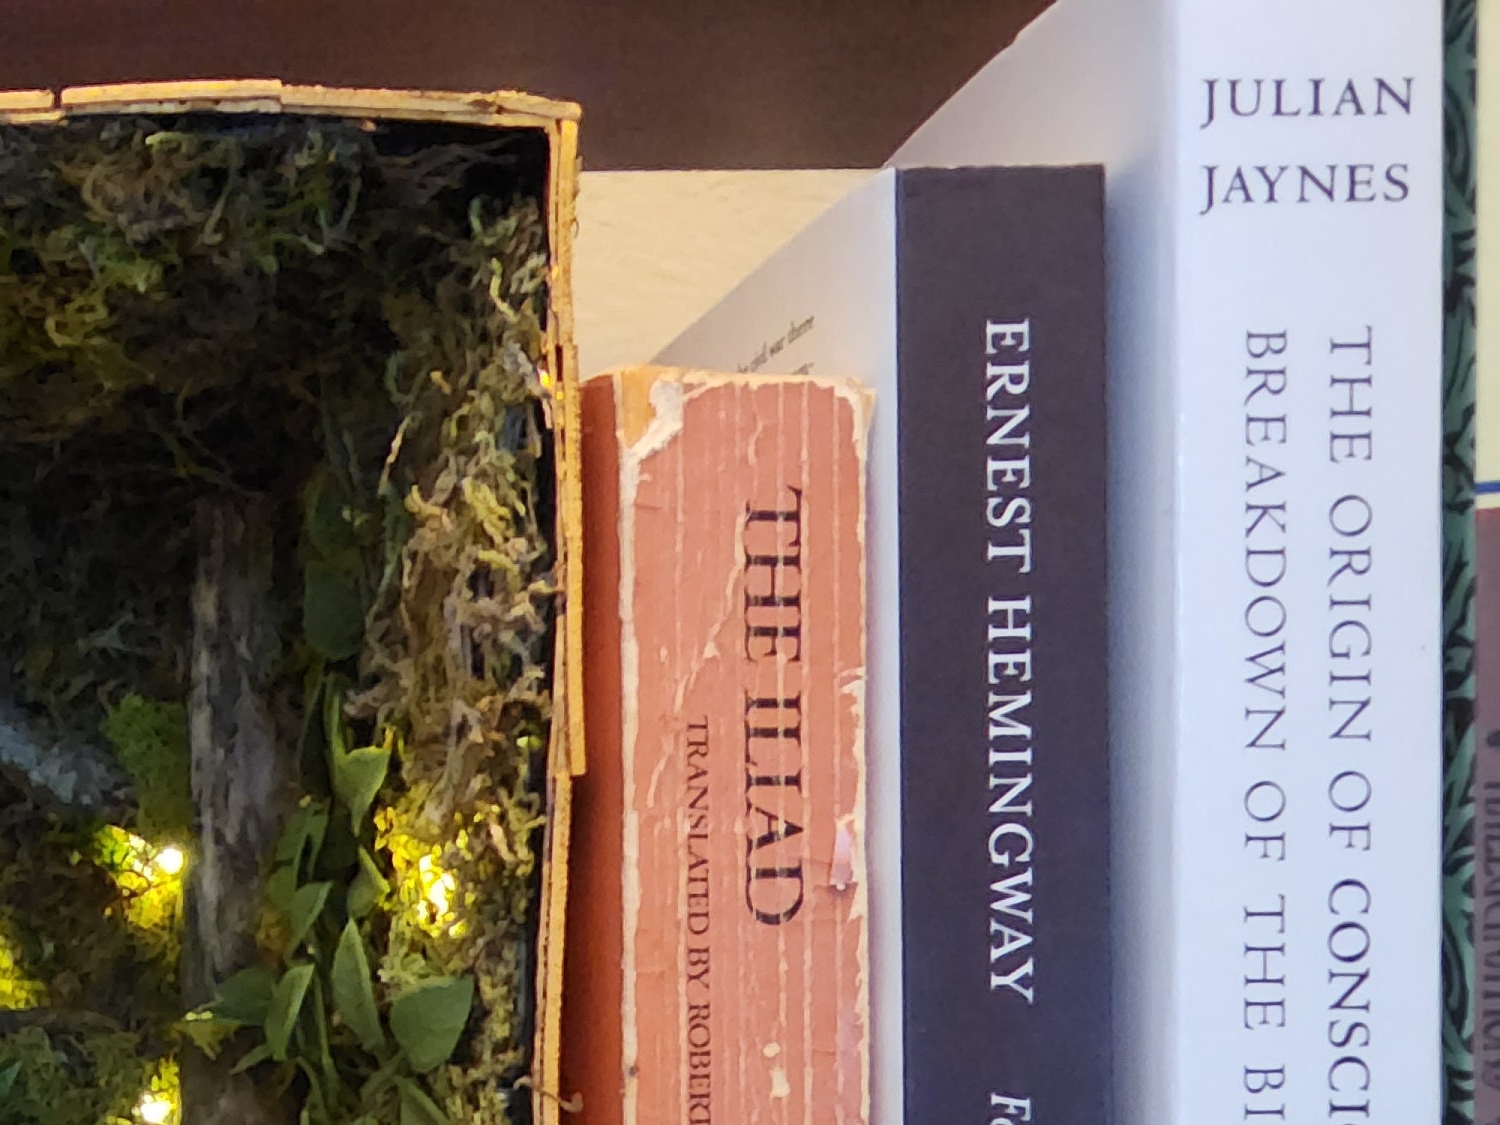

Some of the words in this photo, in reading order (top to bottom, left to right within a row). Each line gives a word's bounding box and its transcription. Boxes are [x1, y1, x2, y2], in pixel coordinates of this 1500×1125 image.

[1200, 77, 1414, 128] JULIAN
[1200, 164, 1411, 215] JAYNES
[984, 319, 1031, 573] ERNEST
[1328, 326, 1372, 464] THE
[744, 484, 804, 664] THE
[1244, 331, 1288, 751] BREAKDOWN
[1328, 494, 1372, 743] ORIGIN
[687, 715, 710, 935] TRANSLATED
[744, 690, 805, 926] ILIAD
[986, 596, 1035, 1003] HEMINGWAY
[1244, 780, 1286, 862] OF
[1328, 770, 1371, 851] OF
[688, 946, 711, 989] BY
[1244, 894, 1286, 1030] THE
